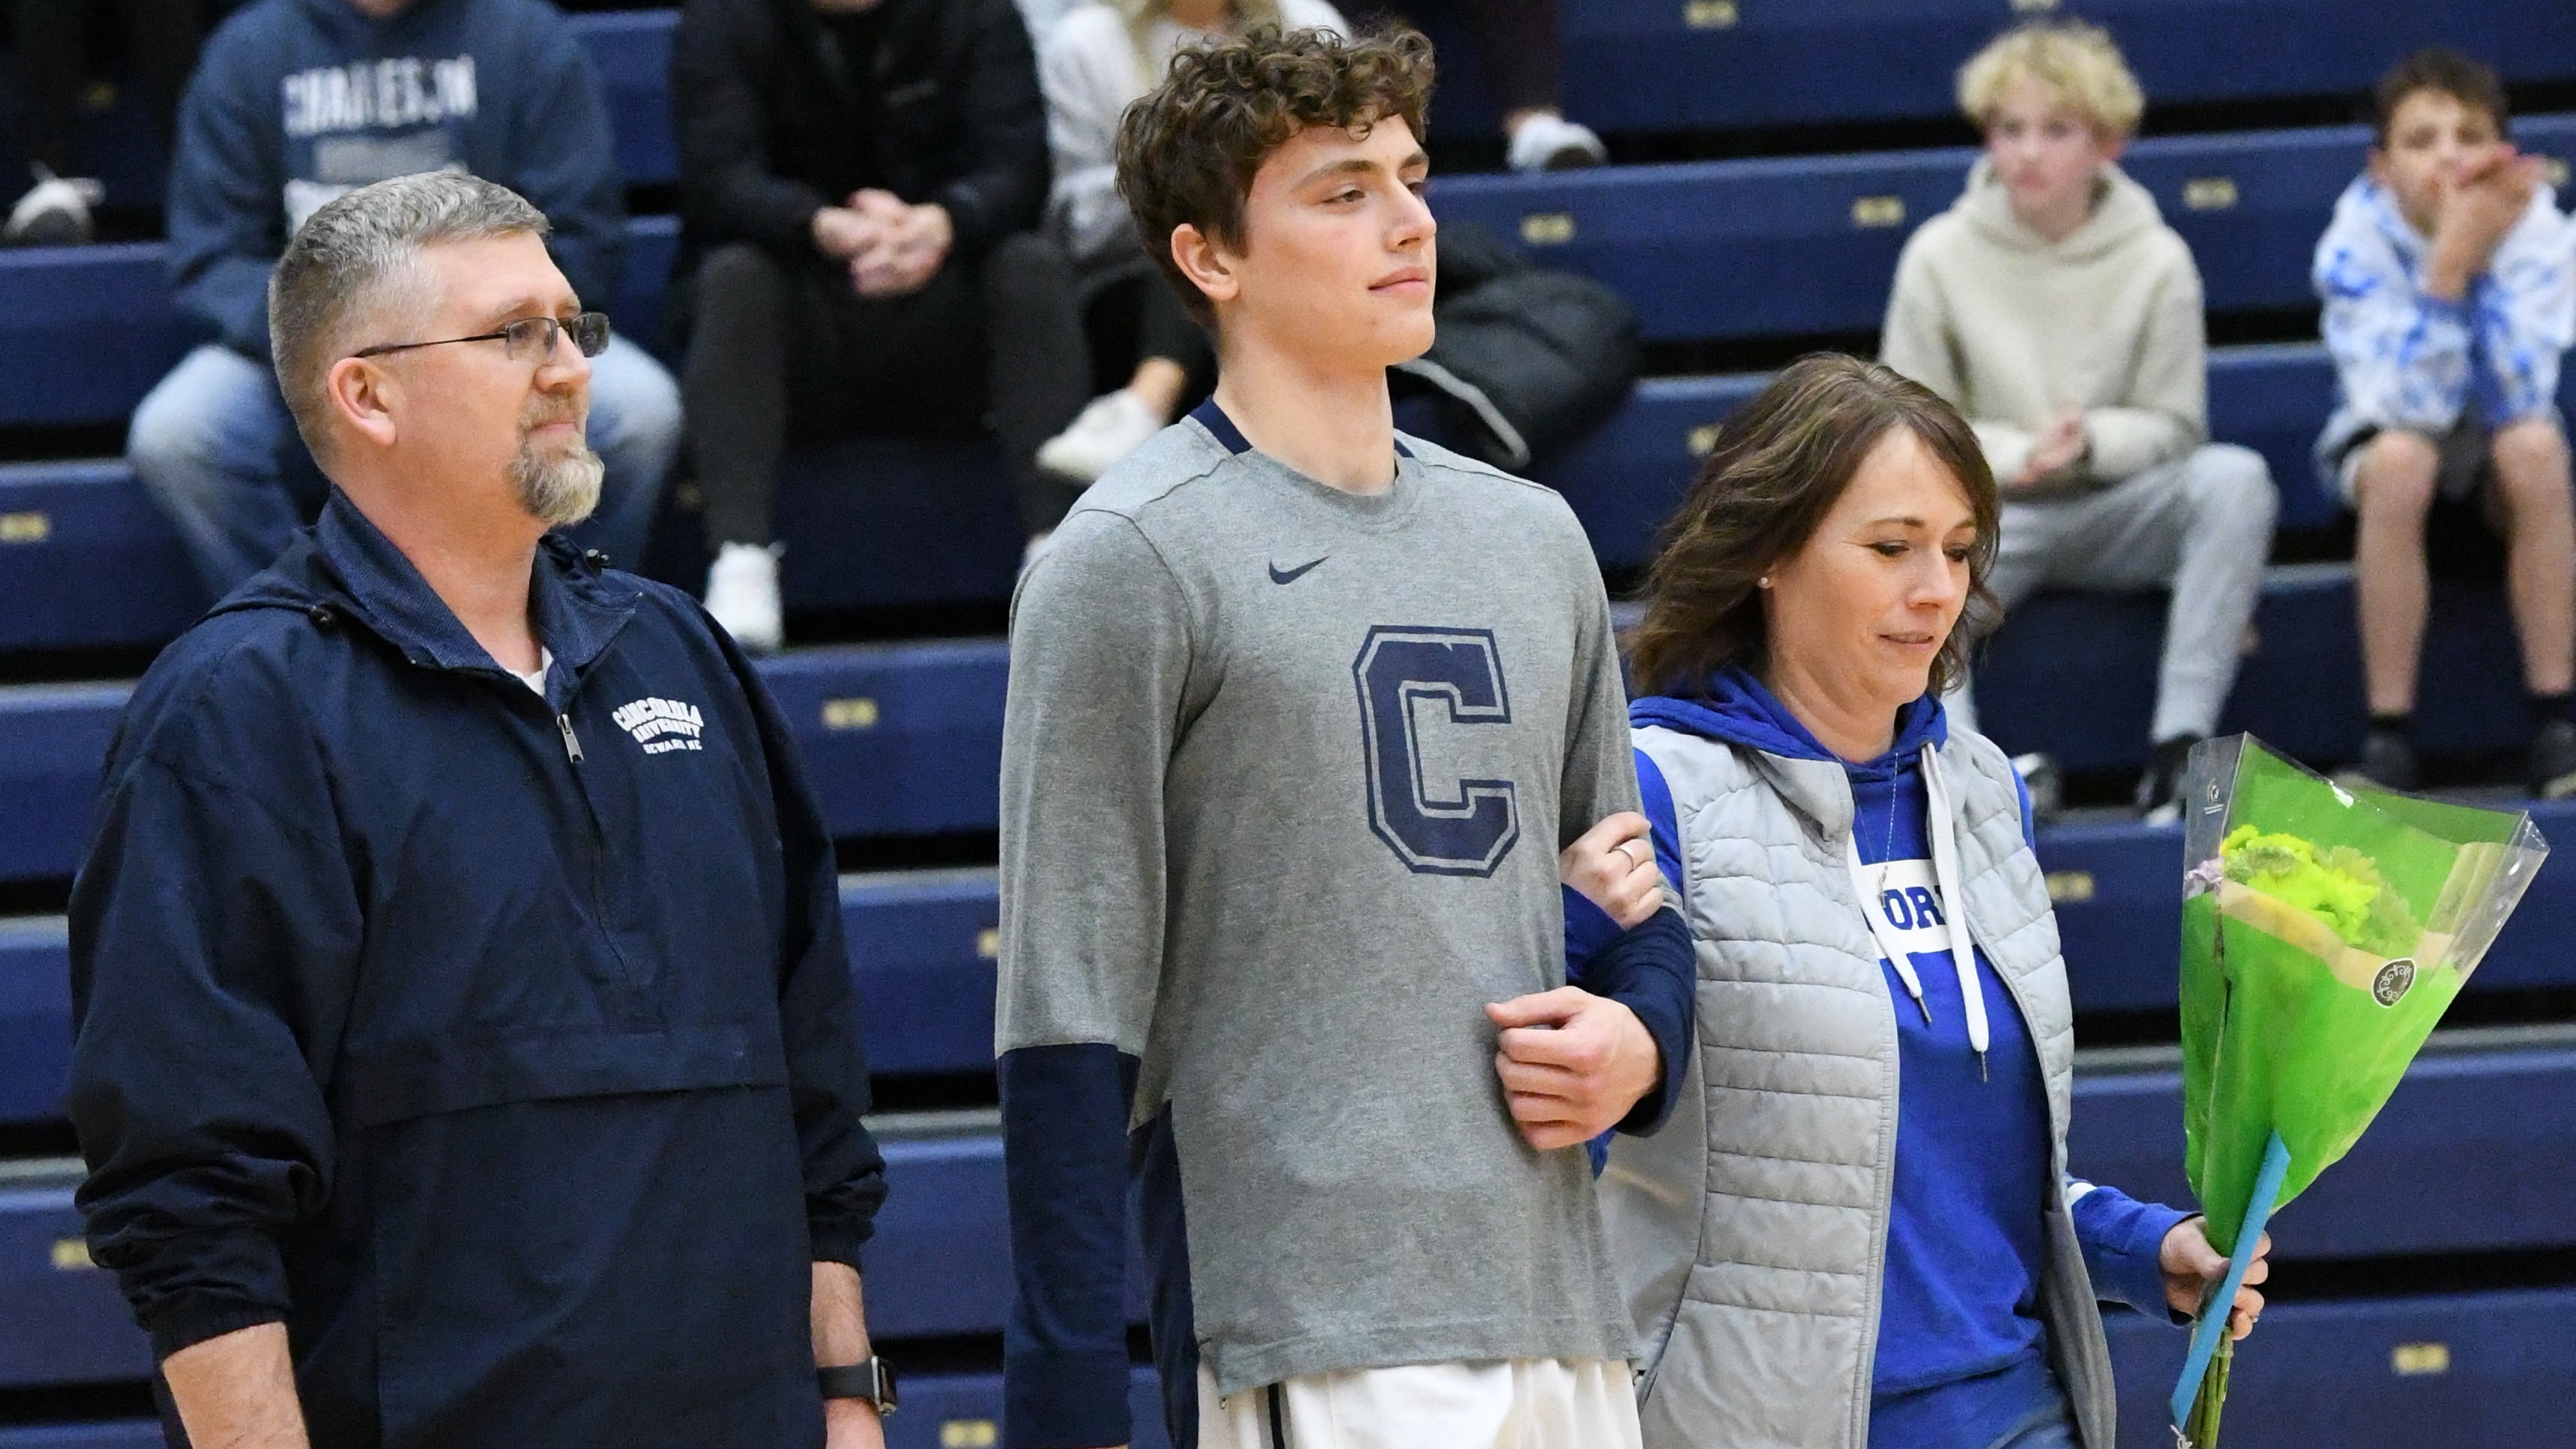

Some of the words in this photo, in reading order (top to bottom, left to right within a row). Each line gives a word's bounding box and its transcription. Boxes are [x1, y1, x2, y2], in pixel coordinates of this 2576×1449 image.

[612, 697, 704, 732] CONCORDIA
[632, 718, 701, 743] UNIVERSITY
[687, 739, 702, 750] NE
[1352, 625, 1519, 879] C
[1860, 885, 1946, 934] OR
